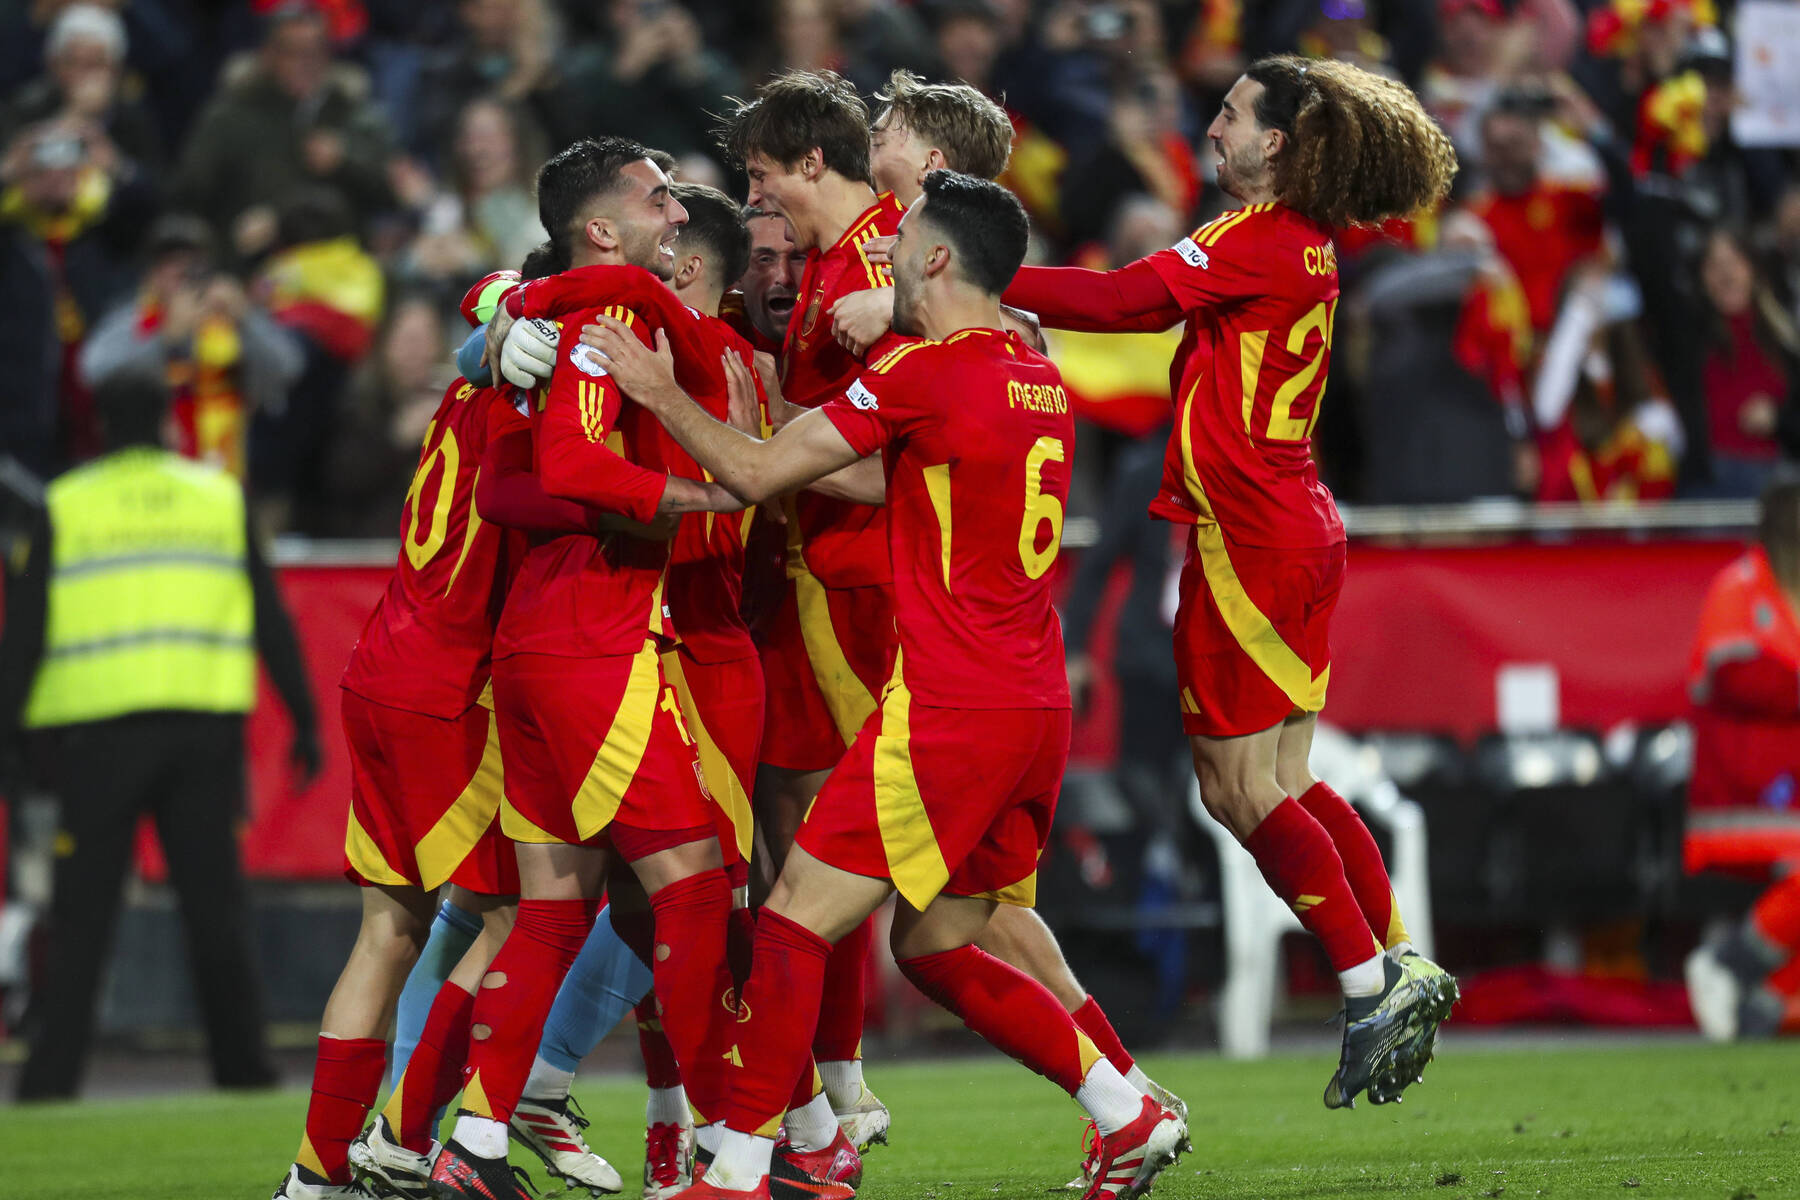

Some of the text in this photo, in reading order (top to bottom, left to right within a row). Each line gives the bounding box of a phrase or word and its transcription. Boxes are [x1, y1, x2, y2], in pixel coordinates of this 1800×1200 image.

[1007, 379, 1067, 415] MERINO
[1266, 297, 1338, 441] 2
[405, 419, 460, 571] 0
[1018, 435, 1065, 581] 6
